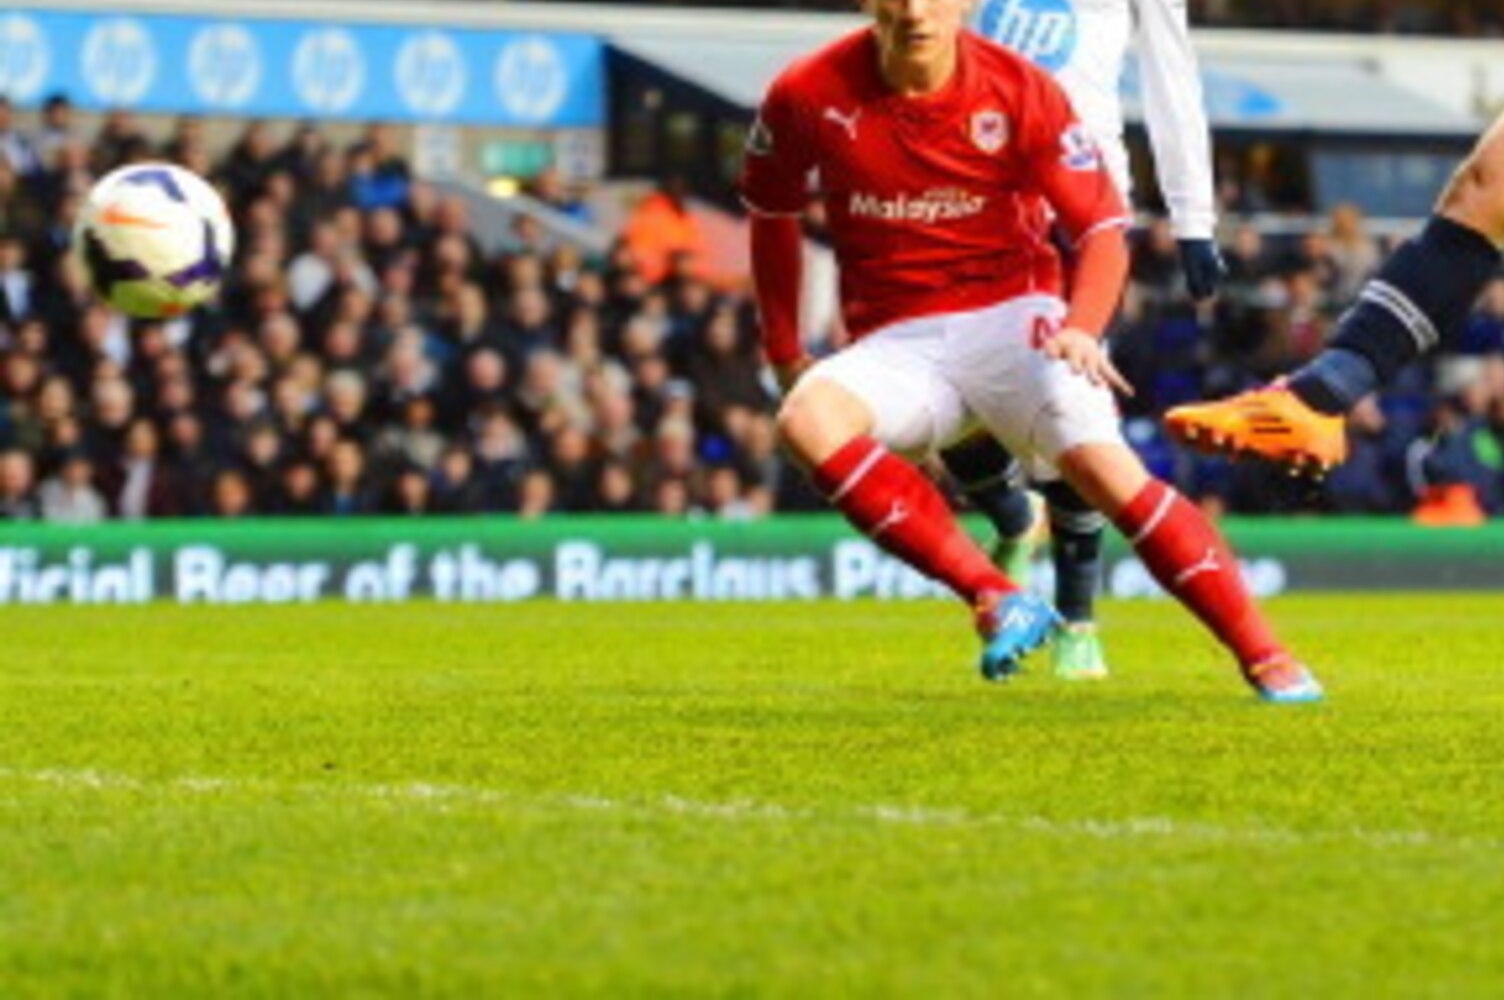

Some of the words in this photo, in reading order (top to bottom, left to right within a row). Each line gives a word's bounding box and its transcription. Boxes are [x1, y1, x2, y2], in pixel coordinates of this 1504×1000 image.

[174, 545, 328, 602] Beer
[346, 542, 418, 601] of
[430, 542, 540, 601] the
